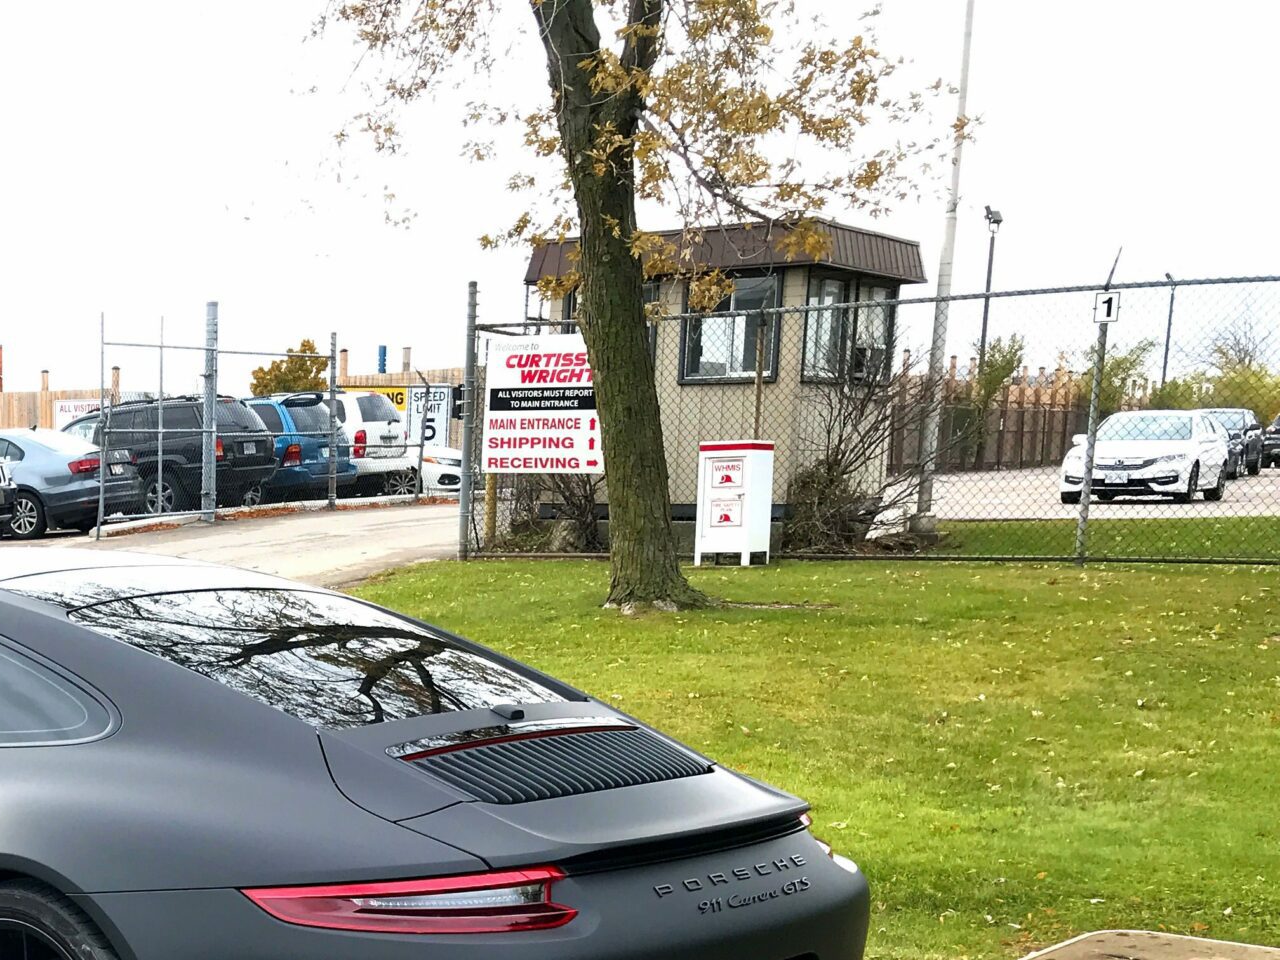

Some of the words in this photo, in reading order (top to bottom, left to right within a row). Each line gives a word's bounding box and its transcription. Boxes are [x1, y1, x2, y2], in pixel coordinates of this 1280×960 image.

[1102, 297, 1113, 317] 1
[494, 343, 529, 352] Welcome
[531, 343, 540, 351] to
[520, 368, 593, 384] WRIGHT
[414, 392, 446, 402] SPEED
[511, 390, 542, 398] VISITORS
[543, 389, 564, 397] MUST
[564, 389, 594, 397] REPORT
[60, 404, 71, 413] ALL
[510, 400, 520, 408] TO
[520, 400, 540, 408] MAIN
[424, 418, 436, 441] 5
[489, 418, 517, 430] MAIN
[520, 418, 581, 430] ENTRANCE
[488, 437, 574, 449] SHIPPING
[487, 457, 580, 469] RECEIVING
[714, 464, 741, 472] WHMIS
[653, 854, 807, 897] PORSCHE
[698, 897, 723, 914] 911
[728, 889, 780, 909] Carrera
[781, 876, 812, 896] GTS
